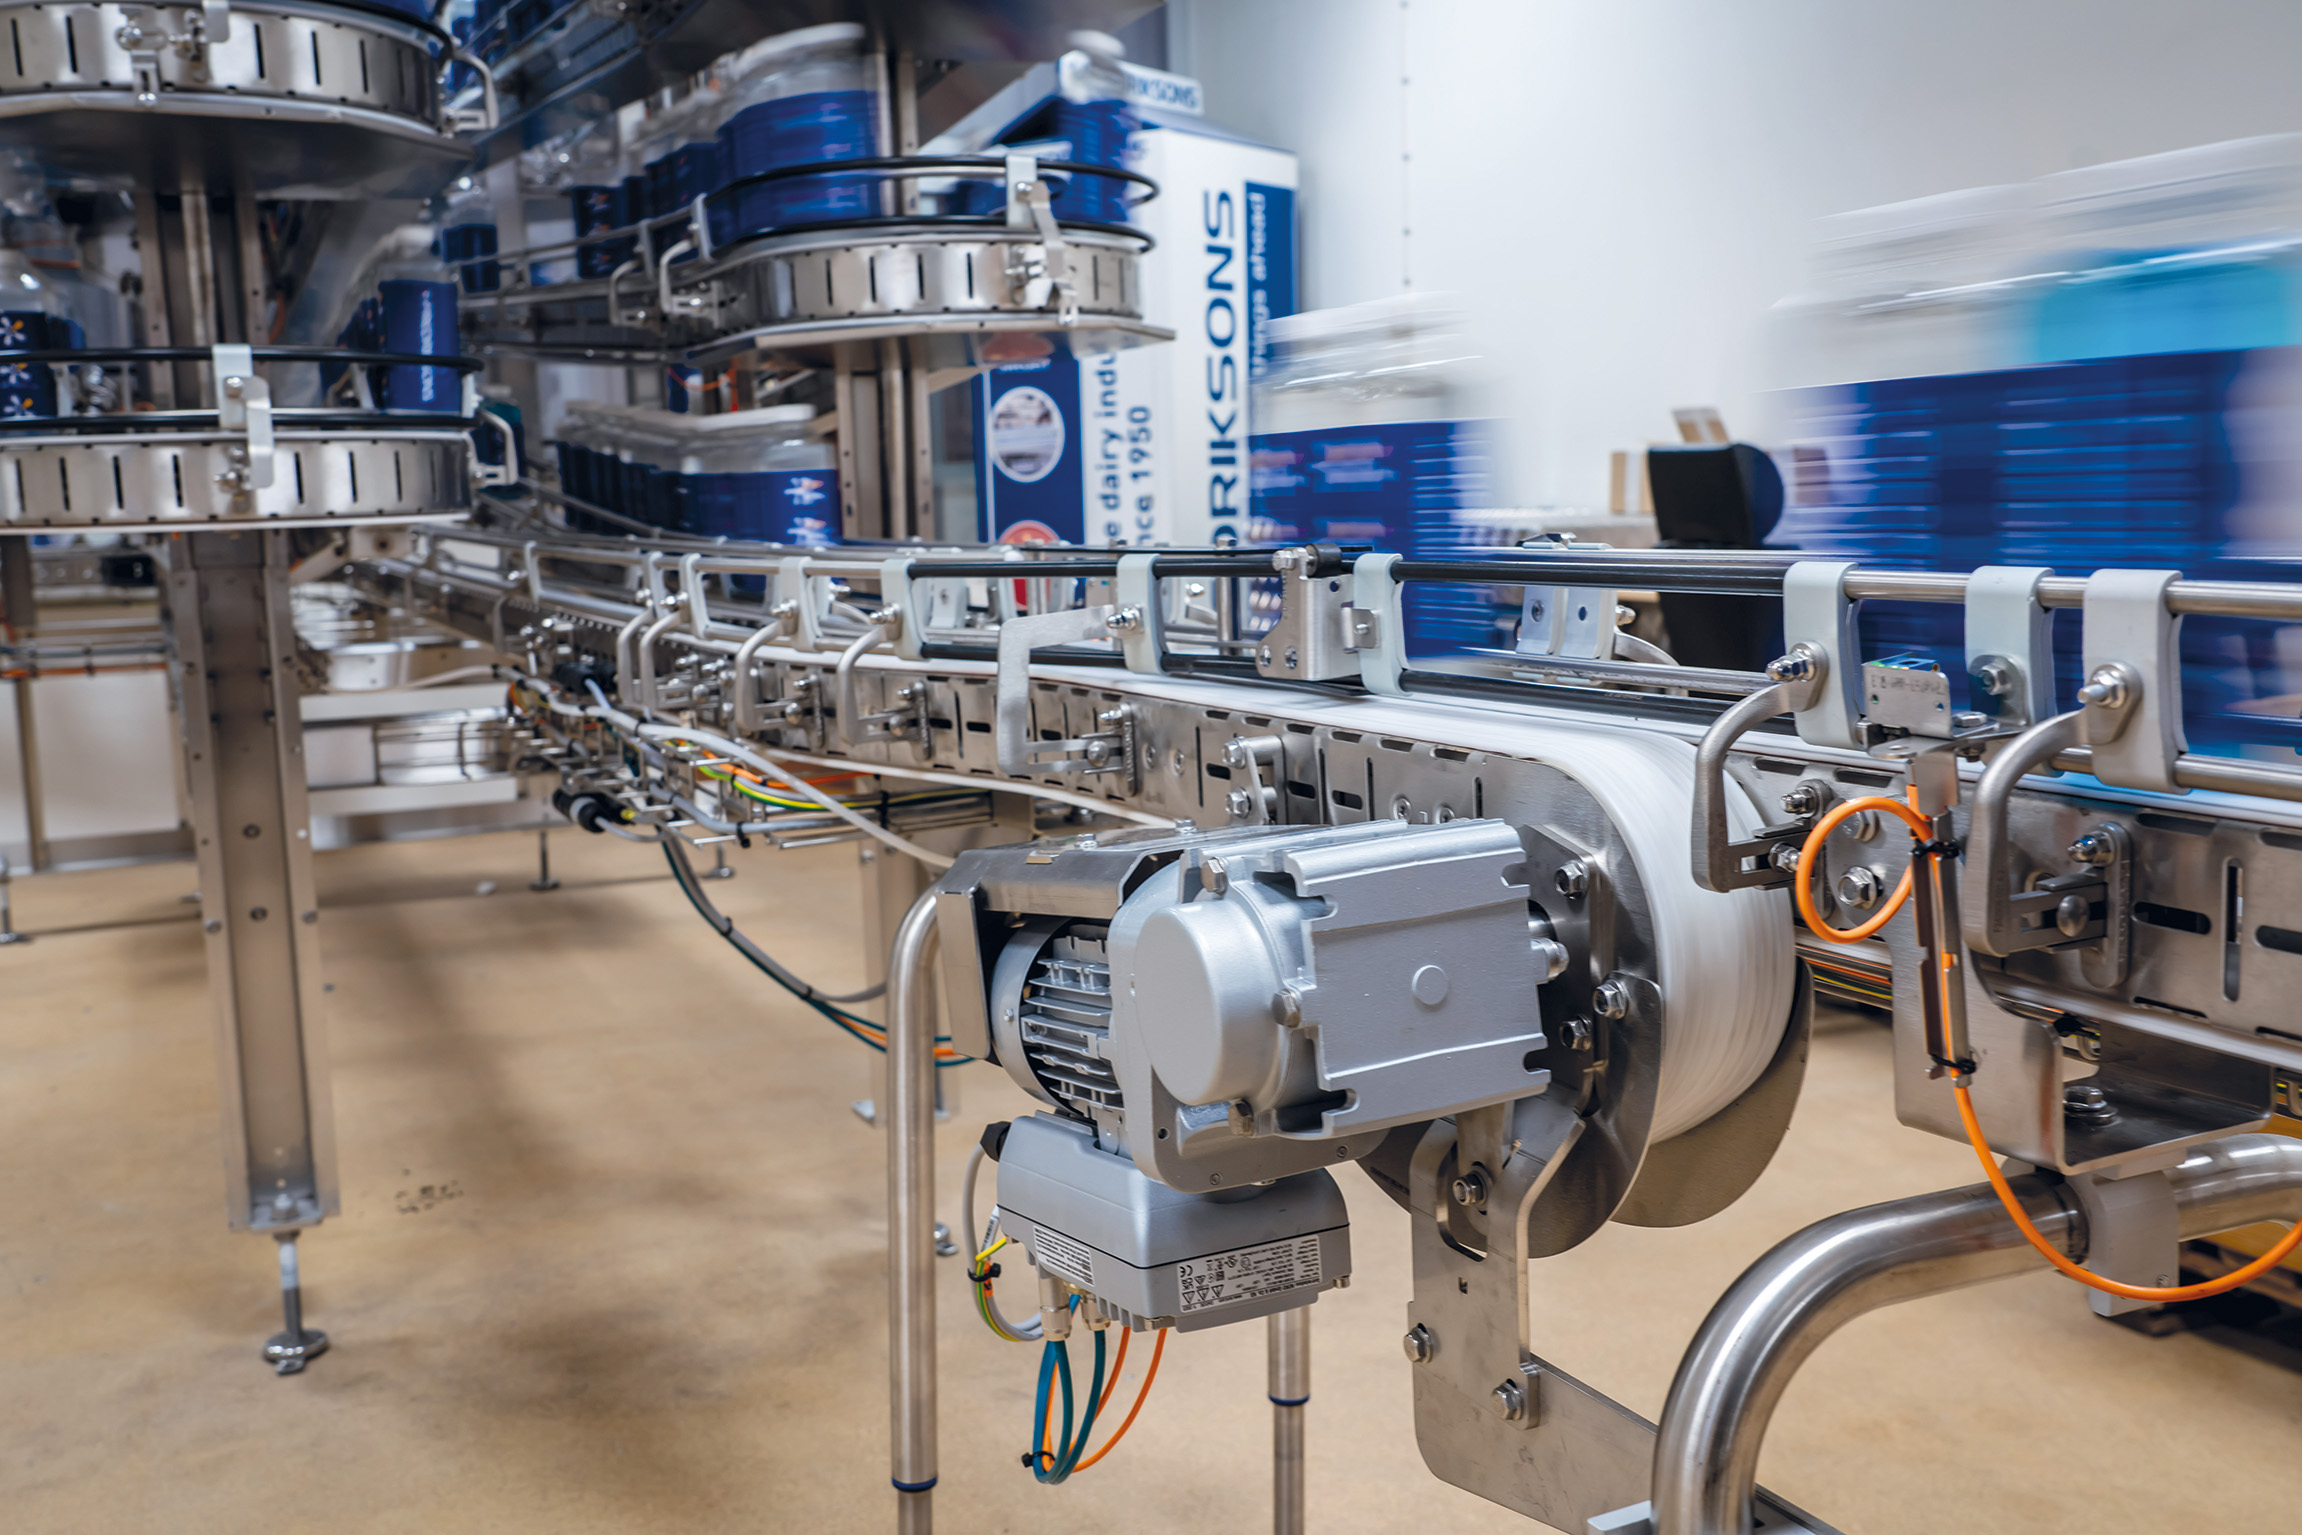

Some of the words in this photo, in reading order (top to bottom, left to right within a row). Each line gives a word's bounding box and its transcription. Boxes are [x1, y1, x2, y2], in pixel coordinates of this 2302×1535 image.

[1247, 191, 1268, 281] ahead
[1094, 427, 1124, 511] dairy
[1126, 403, 1154, 483] 1950
